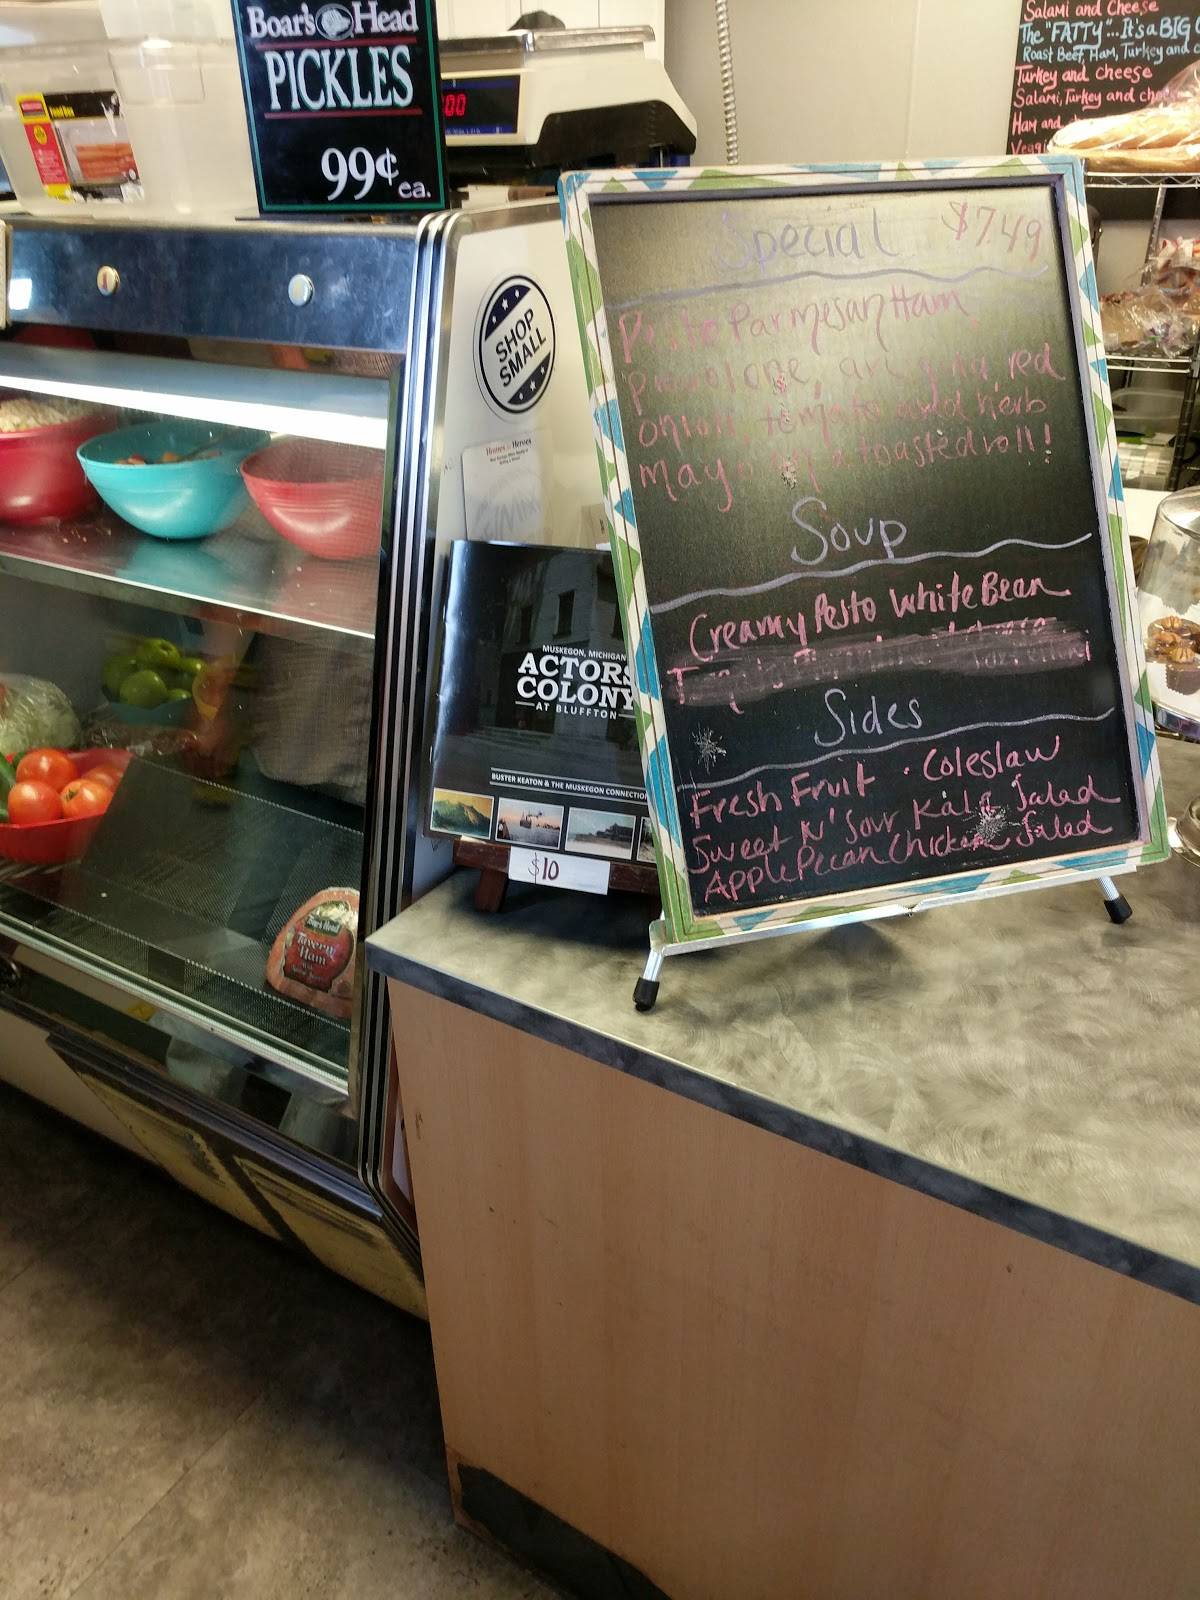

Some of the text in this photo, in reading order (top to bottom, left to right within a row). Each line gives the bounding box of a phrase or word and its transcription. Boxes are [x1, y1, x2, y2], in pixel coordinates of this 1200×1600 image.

[247, 0, 419, 38] Boar's Head
[1019, 21, 1044, 43] The
[1146, 27, 1158, 37] a
[1159, 15, 1191, 41] BIG
[1023, 0, 1069, 22] Salami
[1075, 0, 1102, 17] and
[1023, 46, 1054, 63] Roast
[1122, 41, 1163, 64] Turkey
[1166, 39, 1190, 56] and
[263, 45, 414, 111] PICKLES
[1015, 64, 1058, 92] Turkey
[1061, 63, 1089, 82] and
[1065, 88, 1102, 111] Turkey
[1105, 87, 1135, 103] and
[1012, 112, 1037, 135] Ham
[1041, 116, 1065, 131] and
[321, 147, 400, 201] 99¢
[398, 181, 432, 199] ea.
[717, 207, 900, 273] Special
[495, 308, 535, 363] SHOP
[500, 327, 547, 387] SMALL
[1008, 342, 1067, 381] red
[791, 496, 908, 565] Soup
[689, 612, 809, 662] Creamy
[814, 590, 877, 634] Pesto
[889, 571, 978, 619] White
[517, 652, 632, 685] ACTORS
[542, 644, 627, 662] MUSKEGON, MICHIGAN
[516, 675, 634, 710] COLONY
[535, 702, 617, 720] AT BLUFFTON
[814, 687, 923, 747] Sides
[491, 772, 516, 783] BUSTER
[517, 776, 543, 787] KEATON
[544, 780, 550, 788] &
[550, 781, 564, 789] THE
[565, 782, 605, 795] MUSKEGON
[689, 780, 783, 829] Fresh
[790, 760, 876, 807] Fruit
[688, 824, 794, 874] Sweet
[527, 852, 560, 884] $10
[704, 853, 799, 904] Apple
